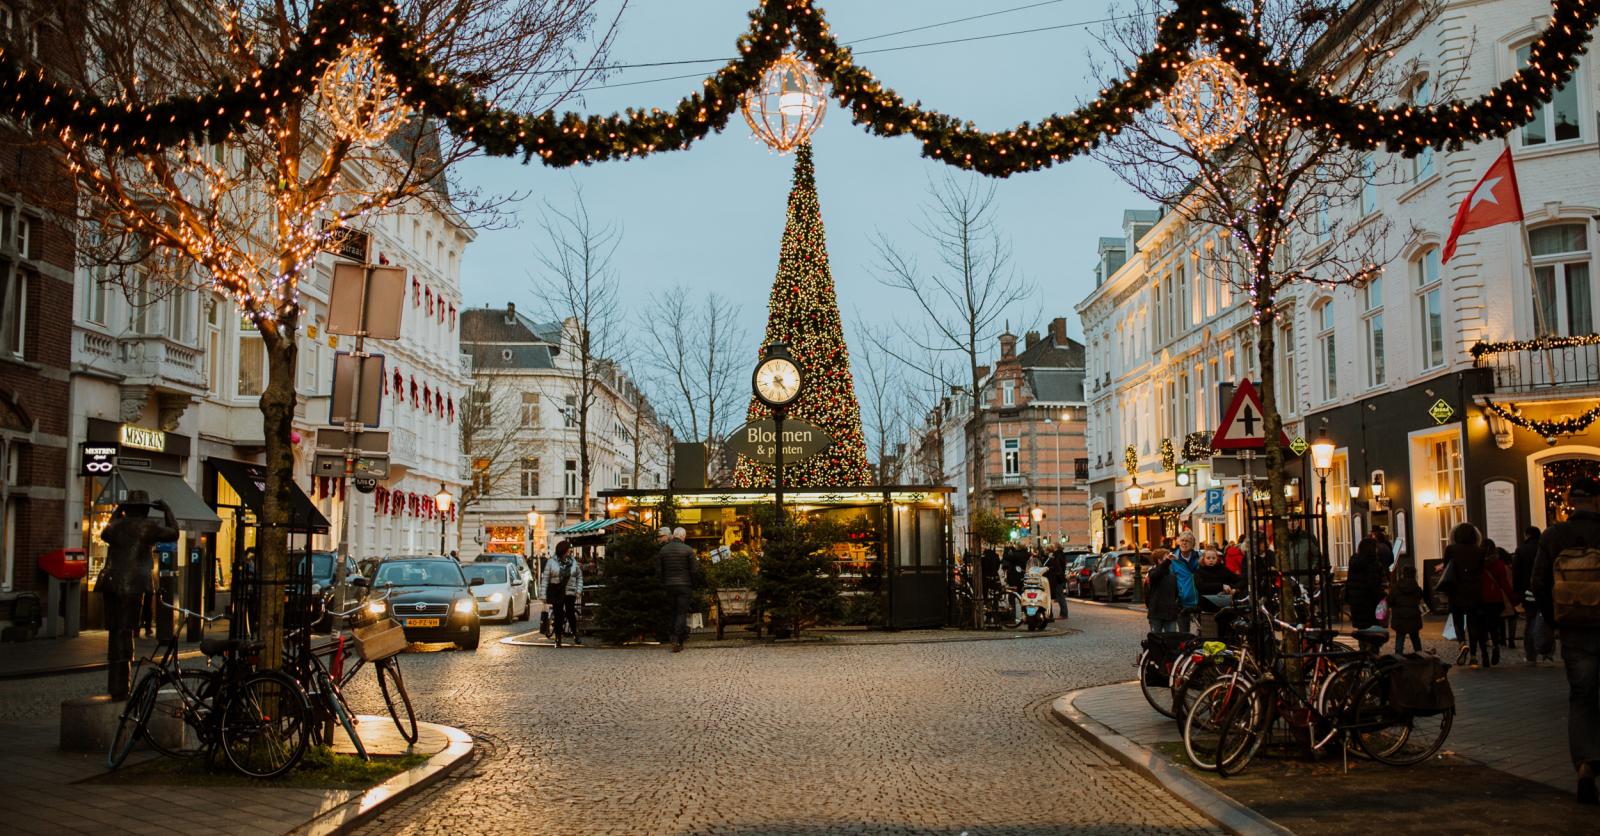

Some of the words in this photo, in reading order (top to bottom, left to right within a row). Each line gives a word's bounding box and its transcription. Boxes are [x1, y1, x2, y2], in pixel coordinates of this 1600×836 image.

[747, 427, 812, 442] Bloemen
[757, 444, 765, 454] &
[768, 445, 803, 458] plnten
[1210, 491, 1219, 504] P
[162, 552, 169, 562] P
[191, 552, 199, 563] P
